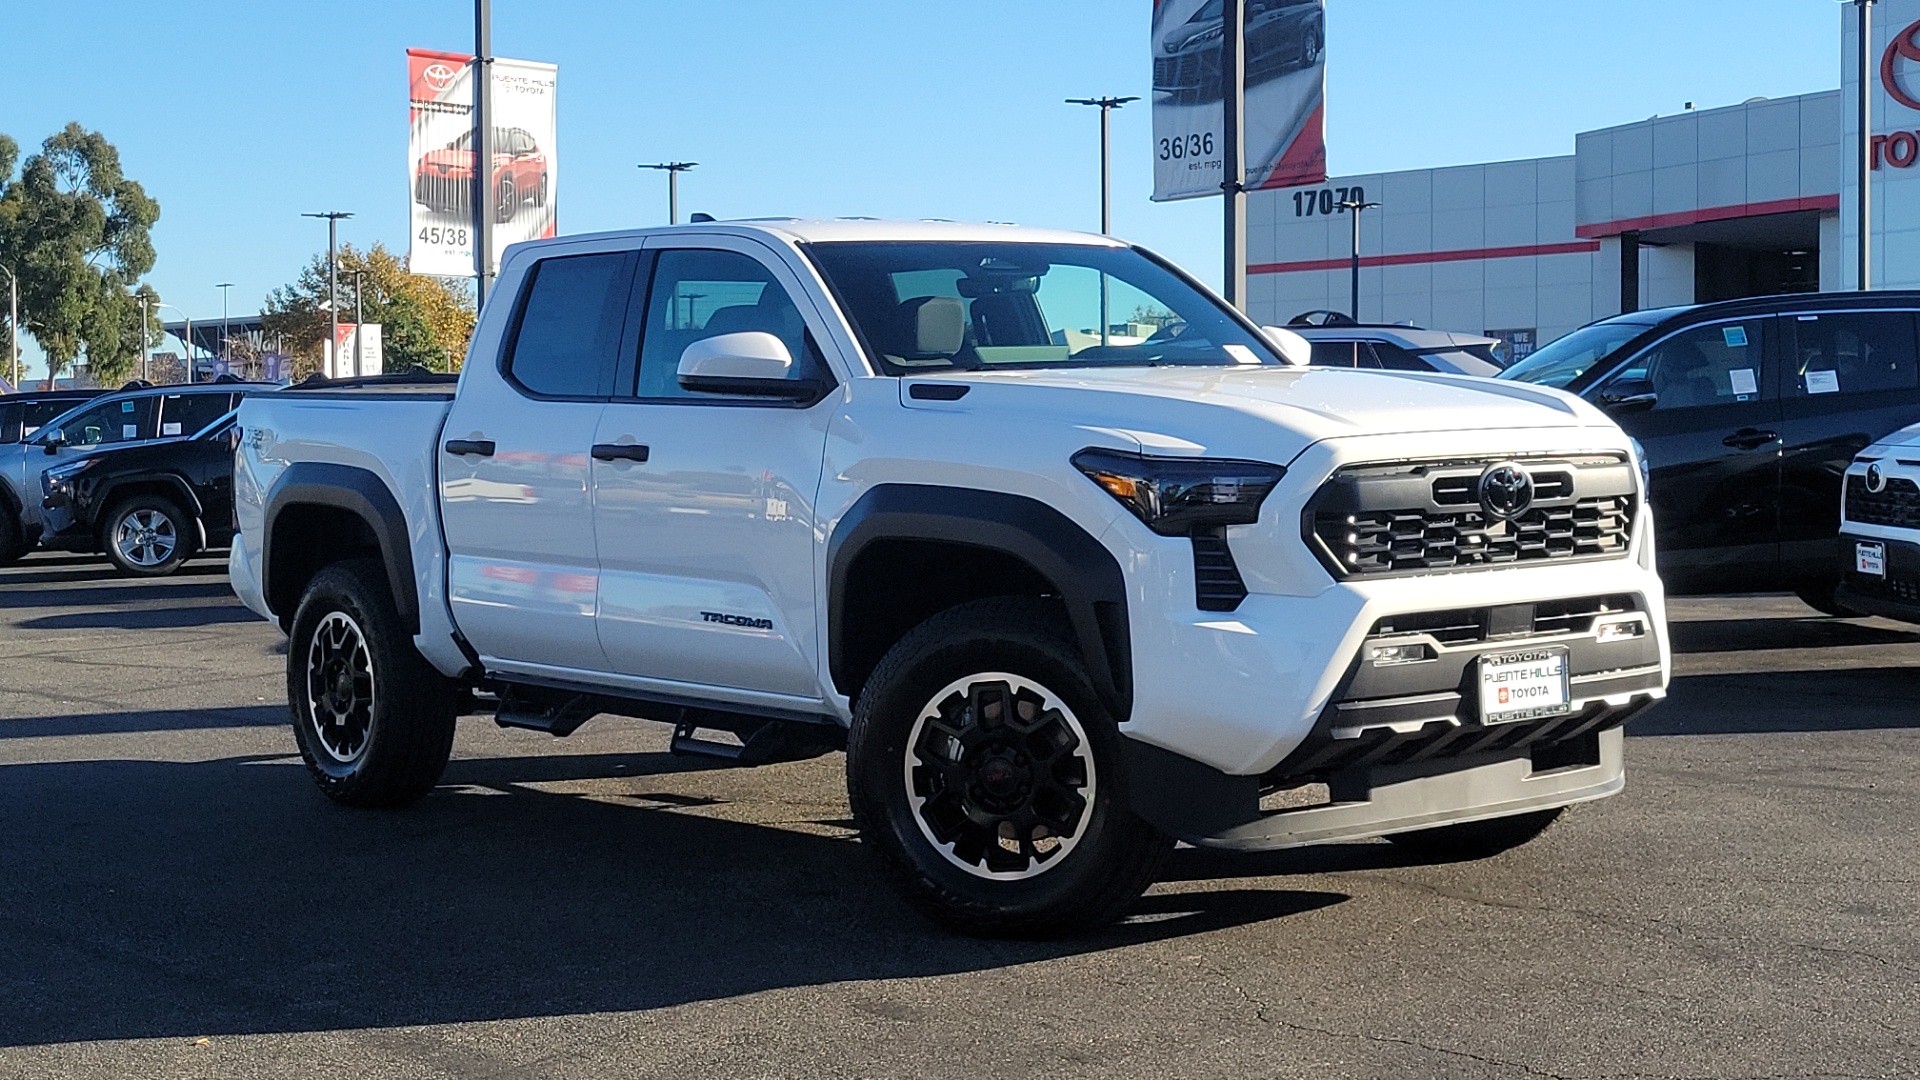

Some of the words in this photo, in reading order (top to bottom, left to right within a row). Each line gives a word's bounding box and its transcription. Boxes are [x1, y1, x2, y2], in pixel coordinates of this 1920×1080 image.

[515, 85, 545, 95] TOYOTA
[1159, 132, 1213, 161] 36/36
[1870, 130, 1920, 171] TO
[1204, 160, 1222, 170] mpg
[418, 226, 467, 246] 45/38
[1513, 332, 1529, 343] WE
[1513, 343, 1534, 354] BUY
[700, 611, 773, 630] TACOMA
[1503, 651, 1548, 664] TOYOTA
[1485, 669, 1528, 684] PUENTE
[1530, 665, 1562, 678] HILLS
[1511, 685, 1550, 699] TOYOTA
